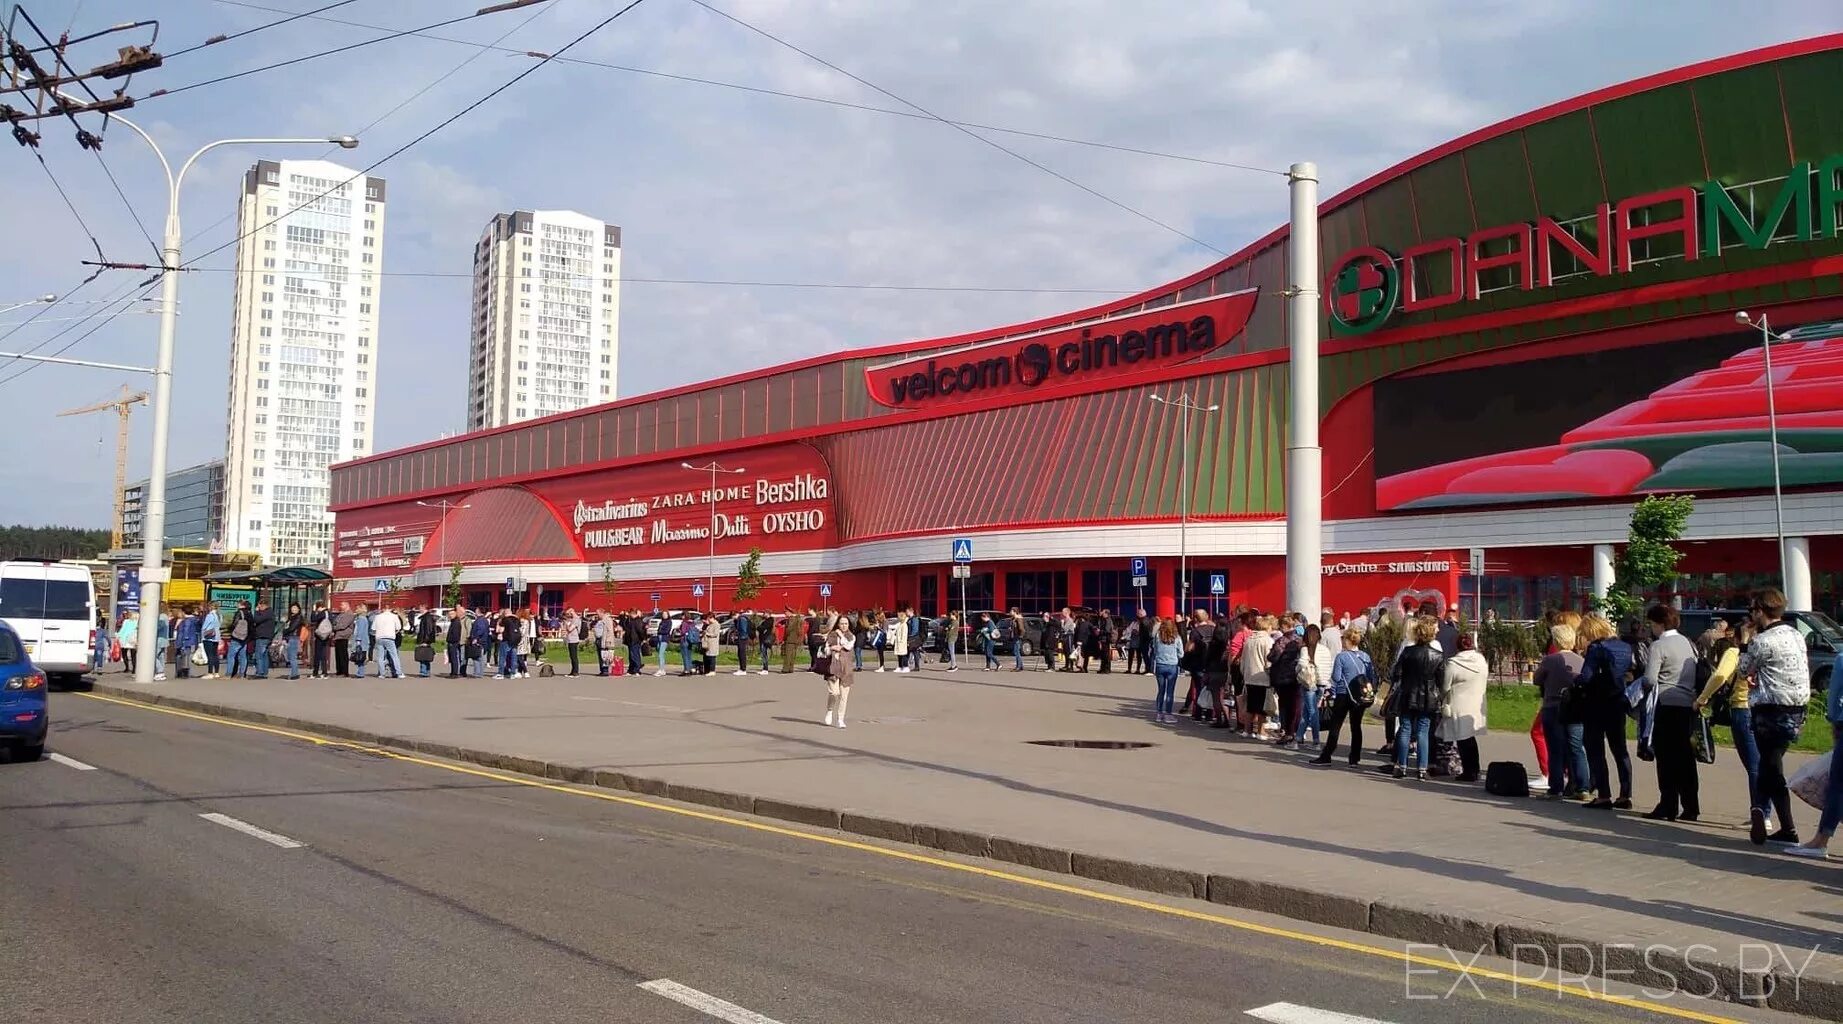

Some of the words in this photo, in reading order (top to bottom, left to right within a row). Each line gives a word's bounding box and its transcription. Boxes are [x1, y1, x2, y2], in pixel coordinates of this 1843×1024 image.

[890, 355, 1010, 403] velcom
[1056, 314, 1216, 374] cinema
[652, 492, 694, 509] ZARA
[701, 486, 751, 504] HOME
[756, 473, 828, 505] Bershka
[651, 519, 710, 544] Massimo
[713, 513, 752, 540] Dutti
[762, 509, 824, 534] OYSHO
[585, 527, 644, 549] PULL&BEAR
[1321, 564, 1335, 576] ny
[1336, 562, 1378, 574] Centre
[1388, 560, 1450, 573] SAMSUNG
